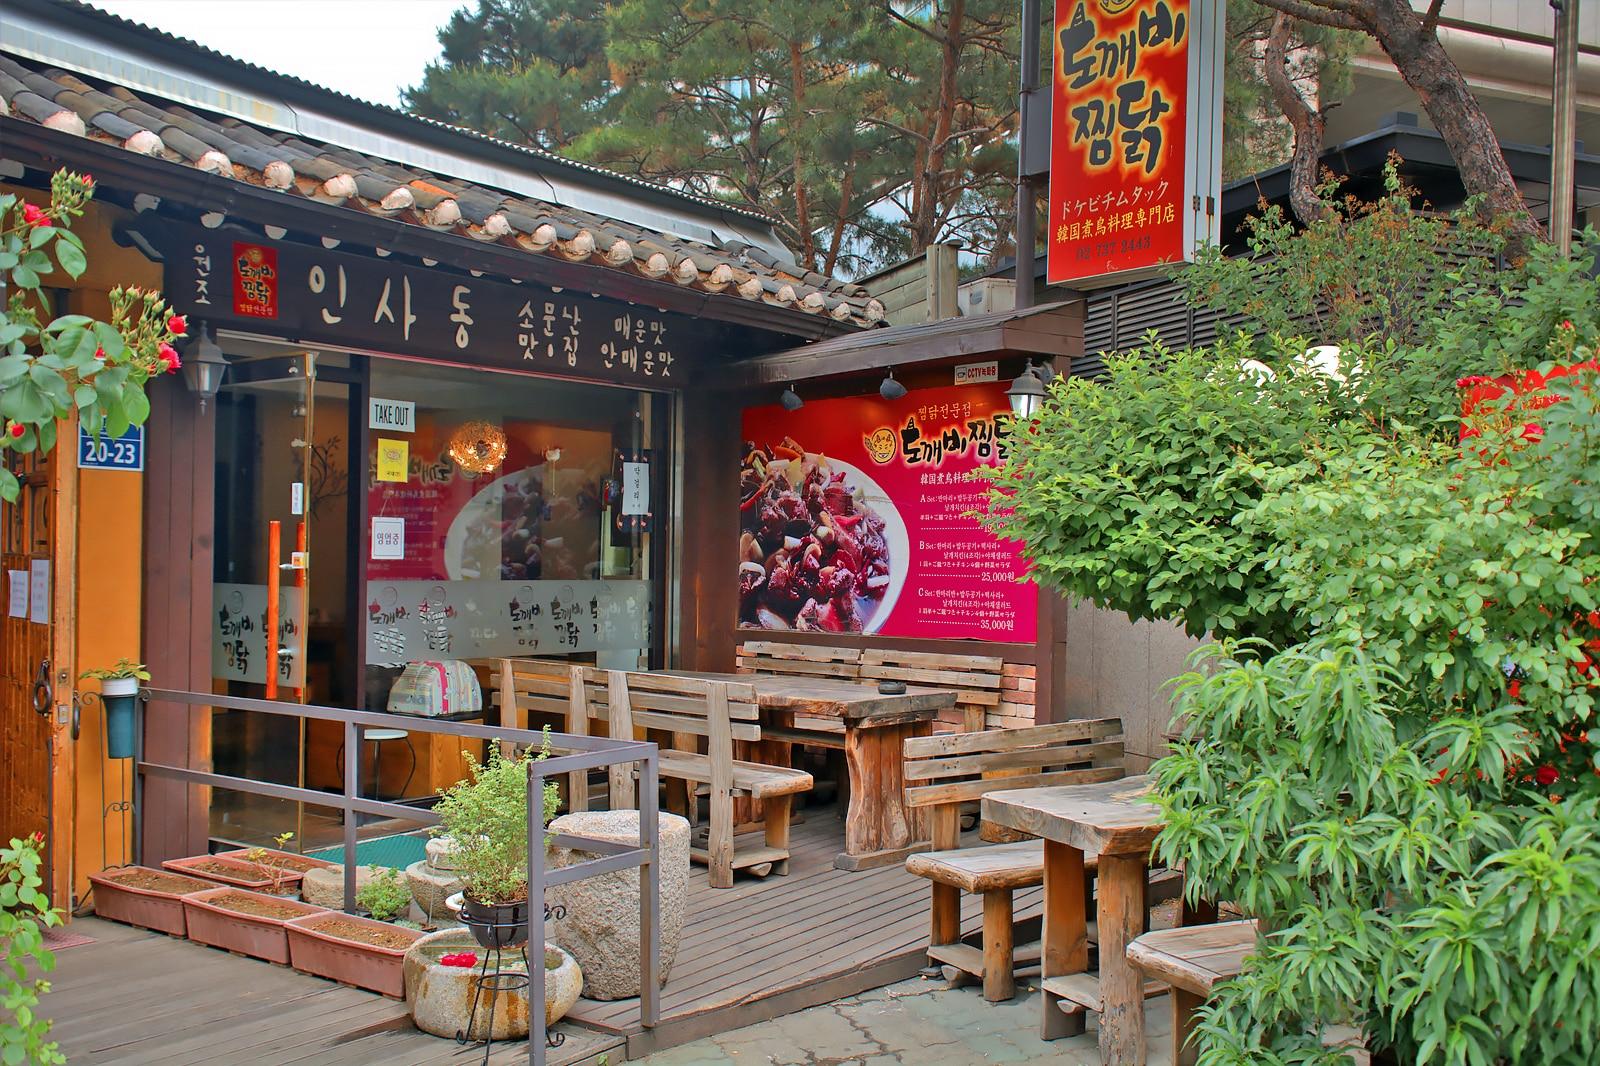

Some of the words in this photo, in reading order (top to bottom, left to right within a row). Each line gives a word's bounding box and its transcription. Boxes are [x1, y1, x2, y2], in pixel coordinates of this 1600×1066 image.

[1060, 2, 1186, 90] 도깨비
[1071, 80, 1170, 174] 찜닭
[1062, 178, 1169, 221] ドケビチムタック
[192, 244, 211, 305] 원조
[309, 264, 474, 349] 인사동
[518, 300, 582, 337] 소문난
[614, 313, 667, 345] 매운맛
[374, 404, 393, 424] TAKE
[395, 406, 409, 426] OUT
[85, 441, 135, 465] 20-23
[376, 533, 400, 545] 영업중
[980, 620, 1015, 631] 35,000원
